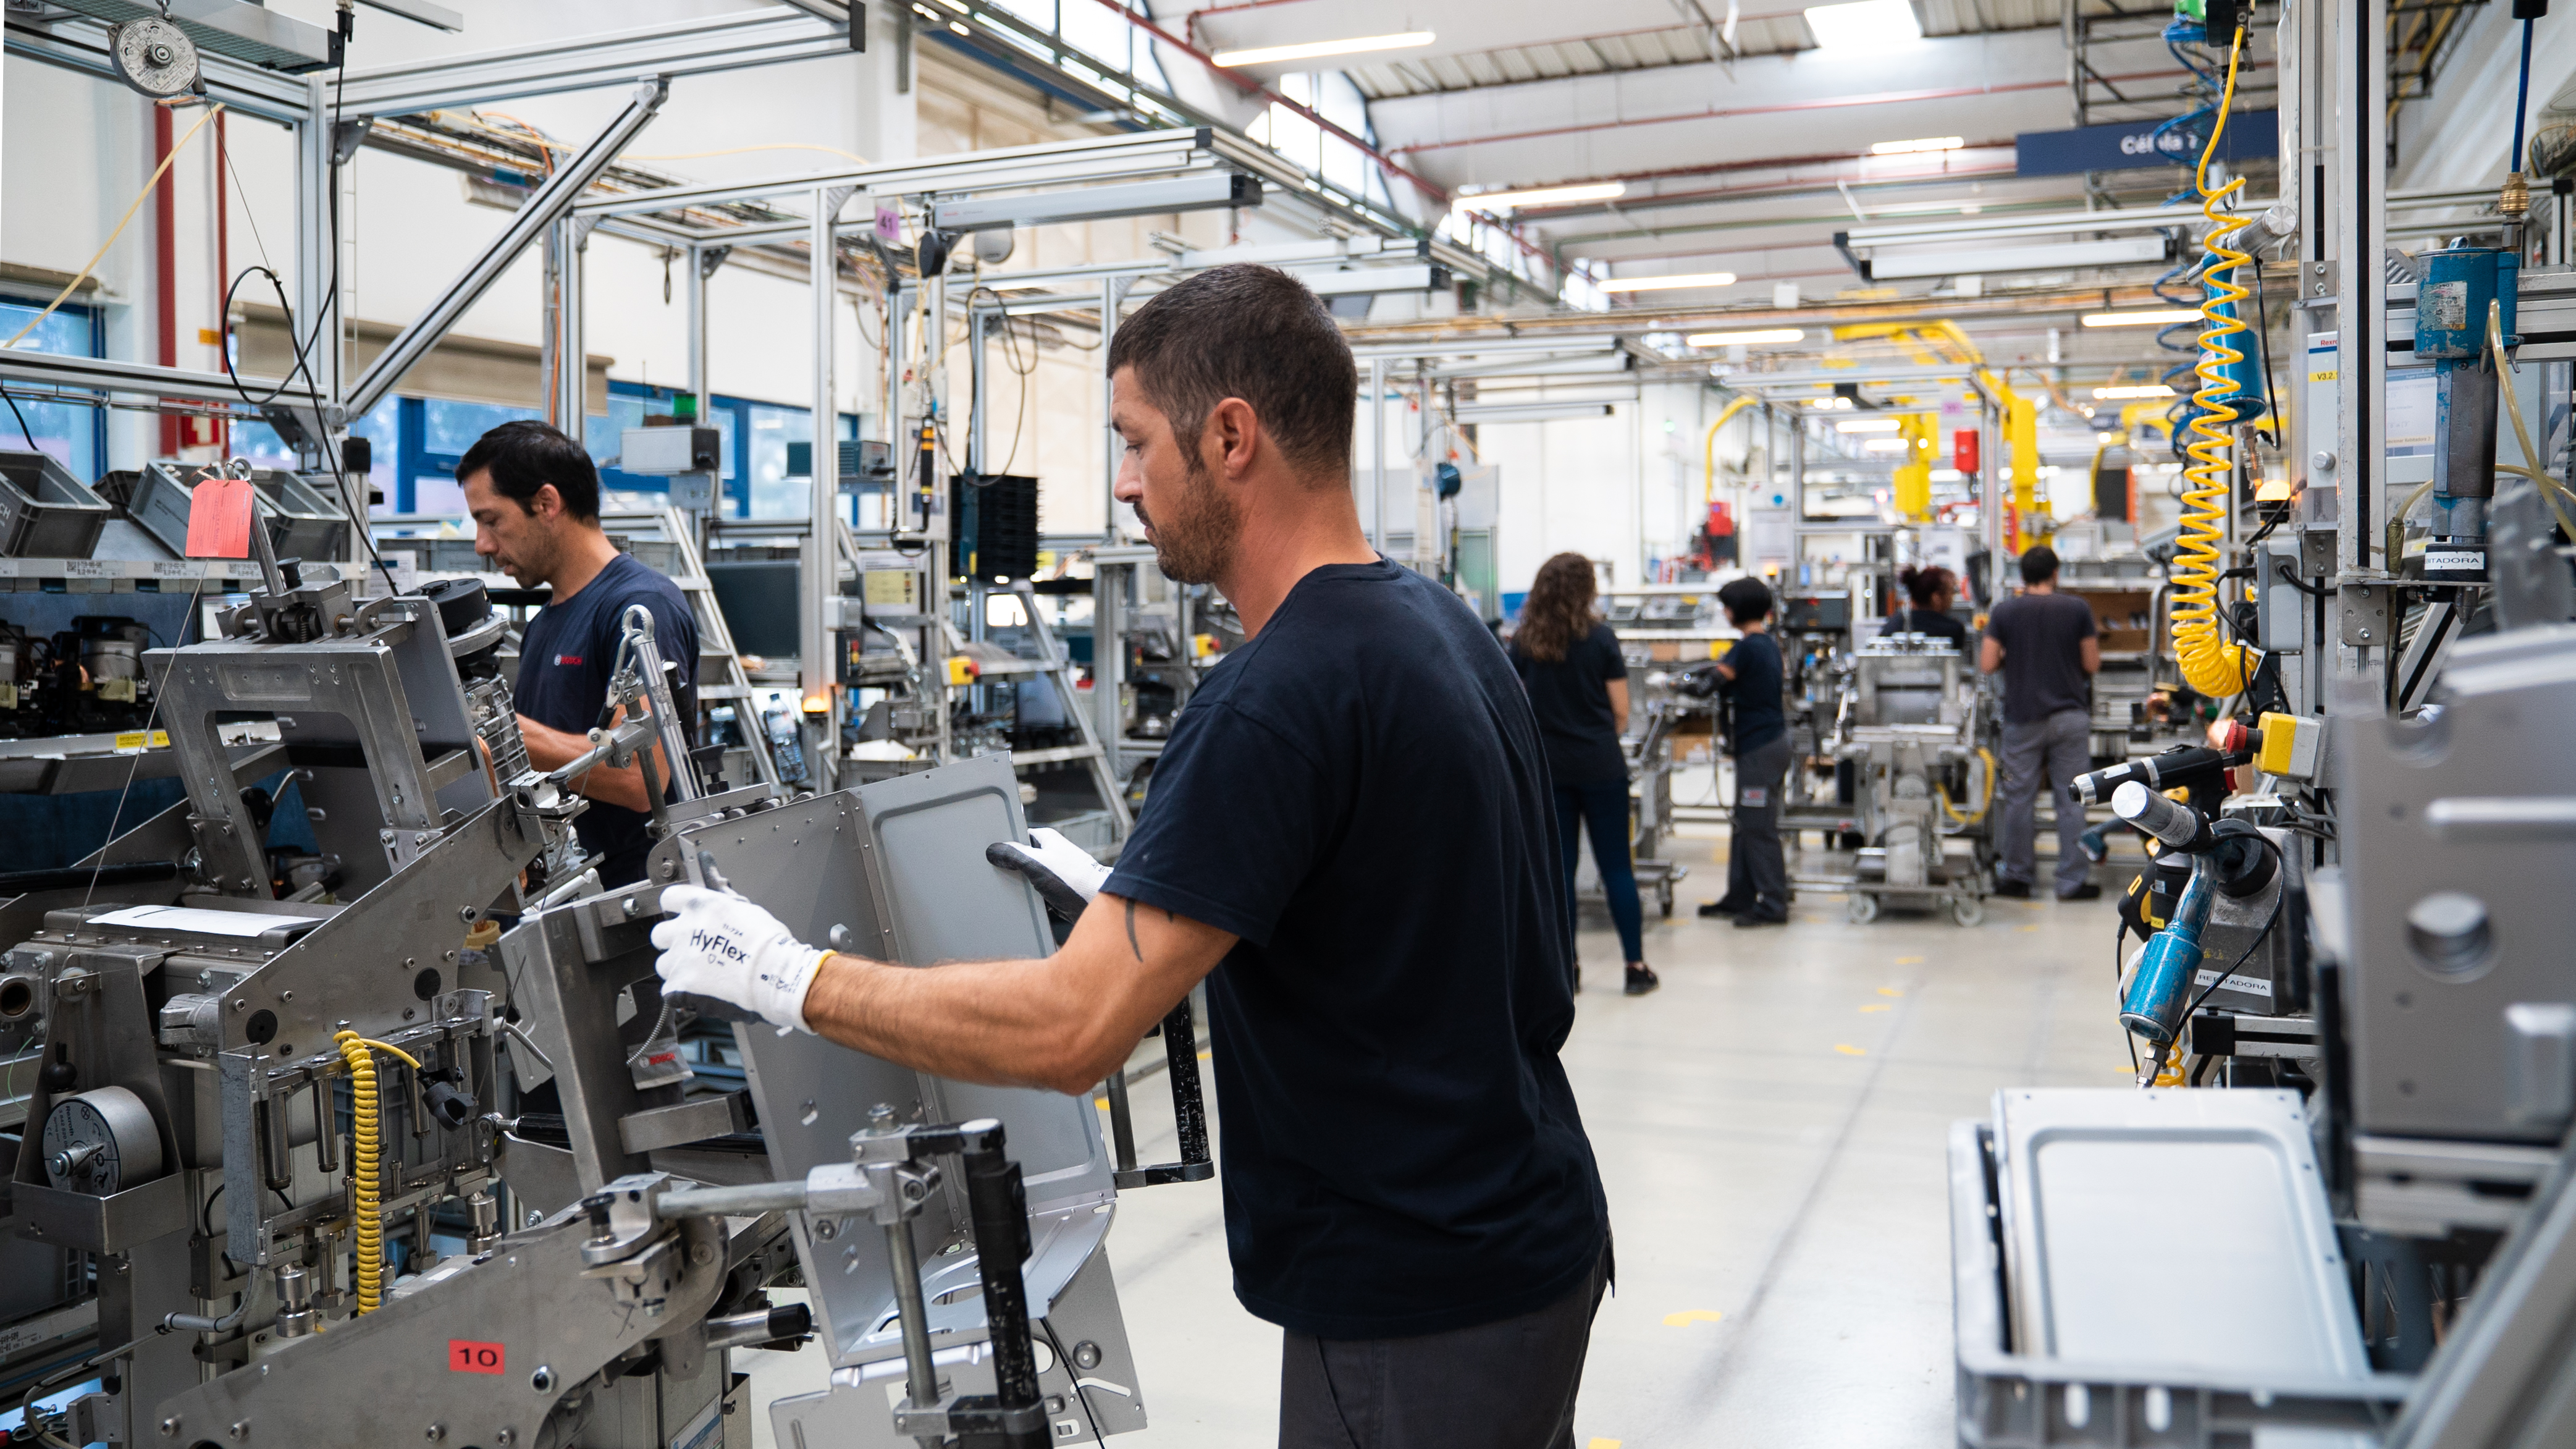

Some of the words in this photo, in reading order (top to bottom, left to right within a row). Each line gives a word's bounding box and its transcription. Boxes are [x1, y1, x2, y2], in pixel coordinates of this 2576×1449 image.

[2317, 372, 2338, 380] V3.2.
[689, 929, 747, 964] HyFlex
[2199, 974, 2267, 991] RETADORA
[65, 1105, 74, 1136] Rexroth
[458, 1348, 498, 1367] 10
